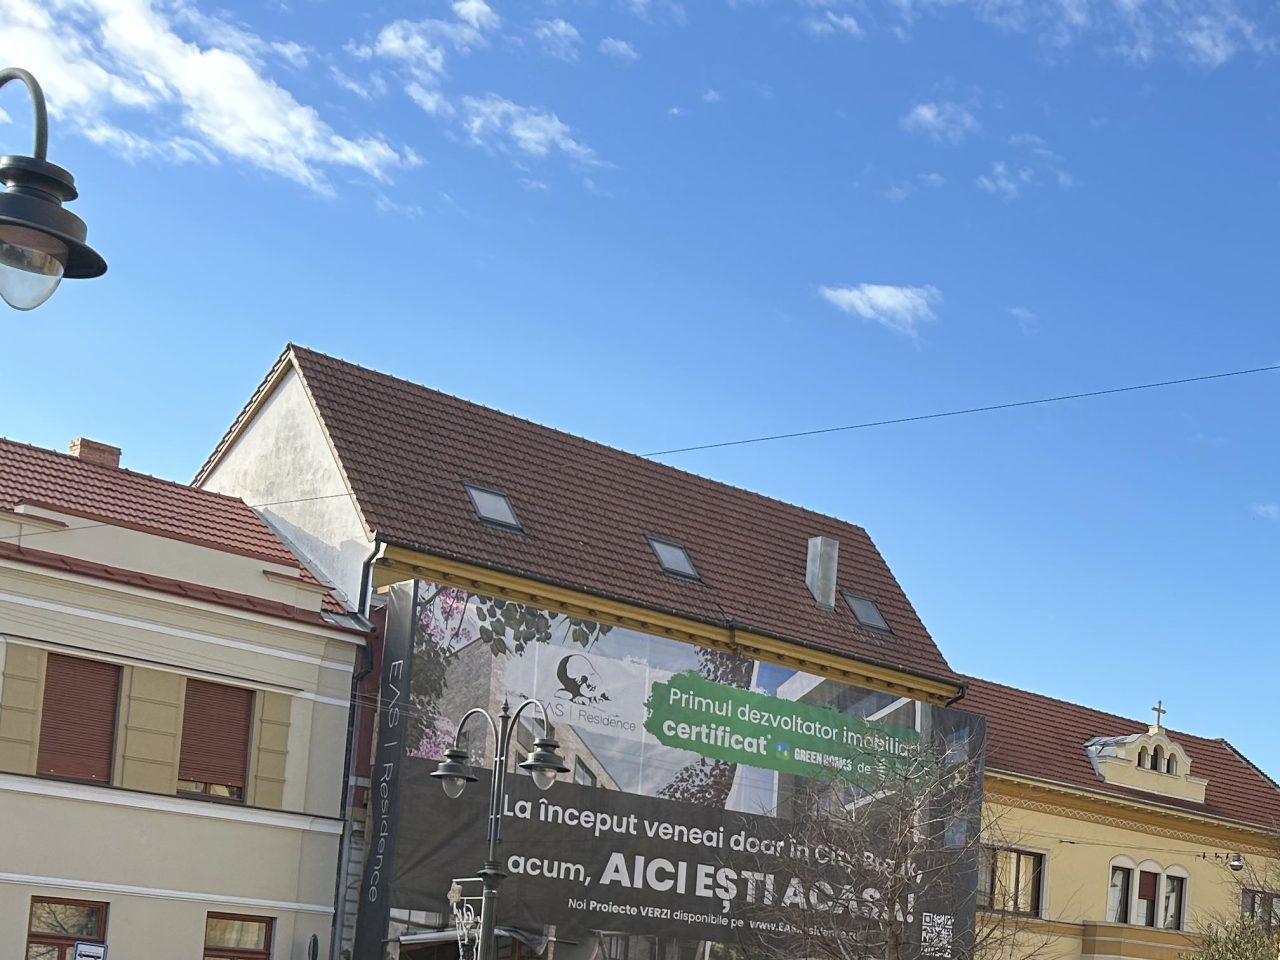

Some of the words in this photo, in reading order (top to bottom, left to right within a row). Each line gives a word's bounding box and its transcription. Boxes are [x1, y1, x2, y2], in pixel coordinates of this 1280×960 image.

[388, 659, 404, 728] EAS
[578, 708, 637, 732] Residence
[669, 687, 732, 718] Primul
[737, 702, 839, 742] dezvoltator
[794, 748, 823, 766] GREEN
[857, 762, 872, 775] de
[368, 762, 394, 902] Residence
[503, 793, 532, 819] La
[538, 797, 638, 837] început
[643, 820, 724, 849] veneai
[729, 830, 785, 858] doar
[507, 854, 592, 887] acum,
[599, 851, 688, 895] AICI
[695, 862, 775, 914] EȘTI
[568, 898, 587, 911] Noi
[589, 900, 638, 916] Proiecte
[640, 906, 671, 920] VERZI
[673, 909, 729, 927] disponibile
[730, 918, 744, 929] pe
